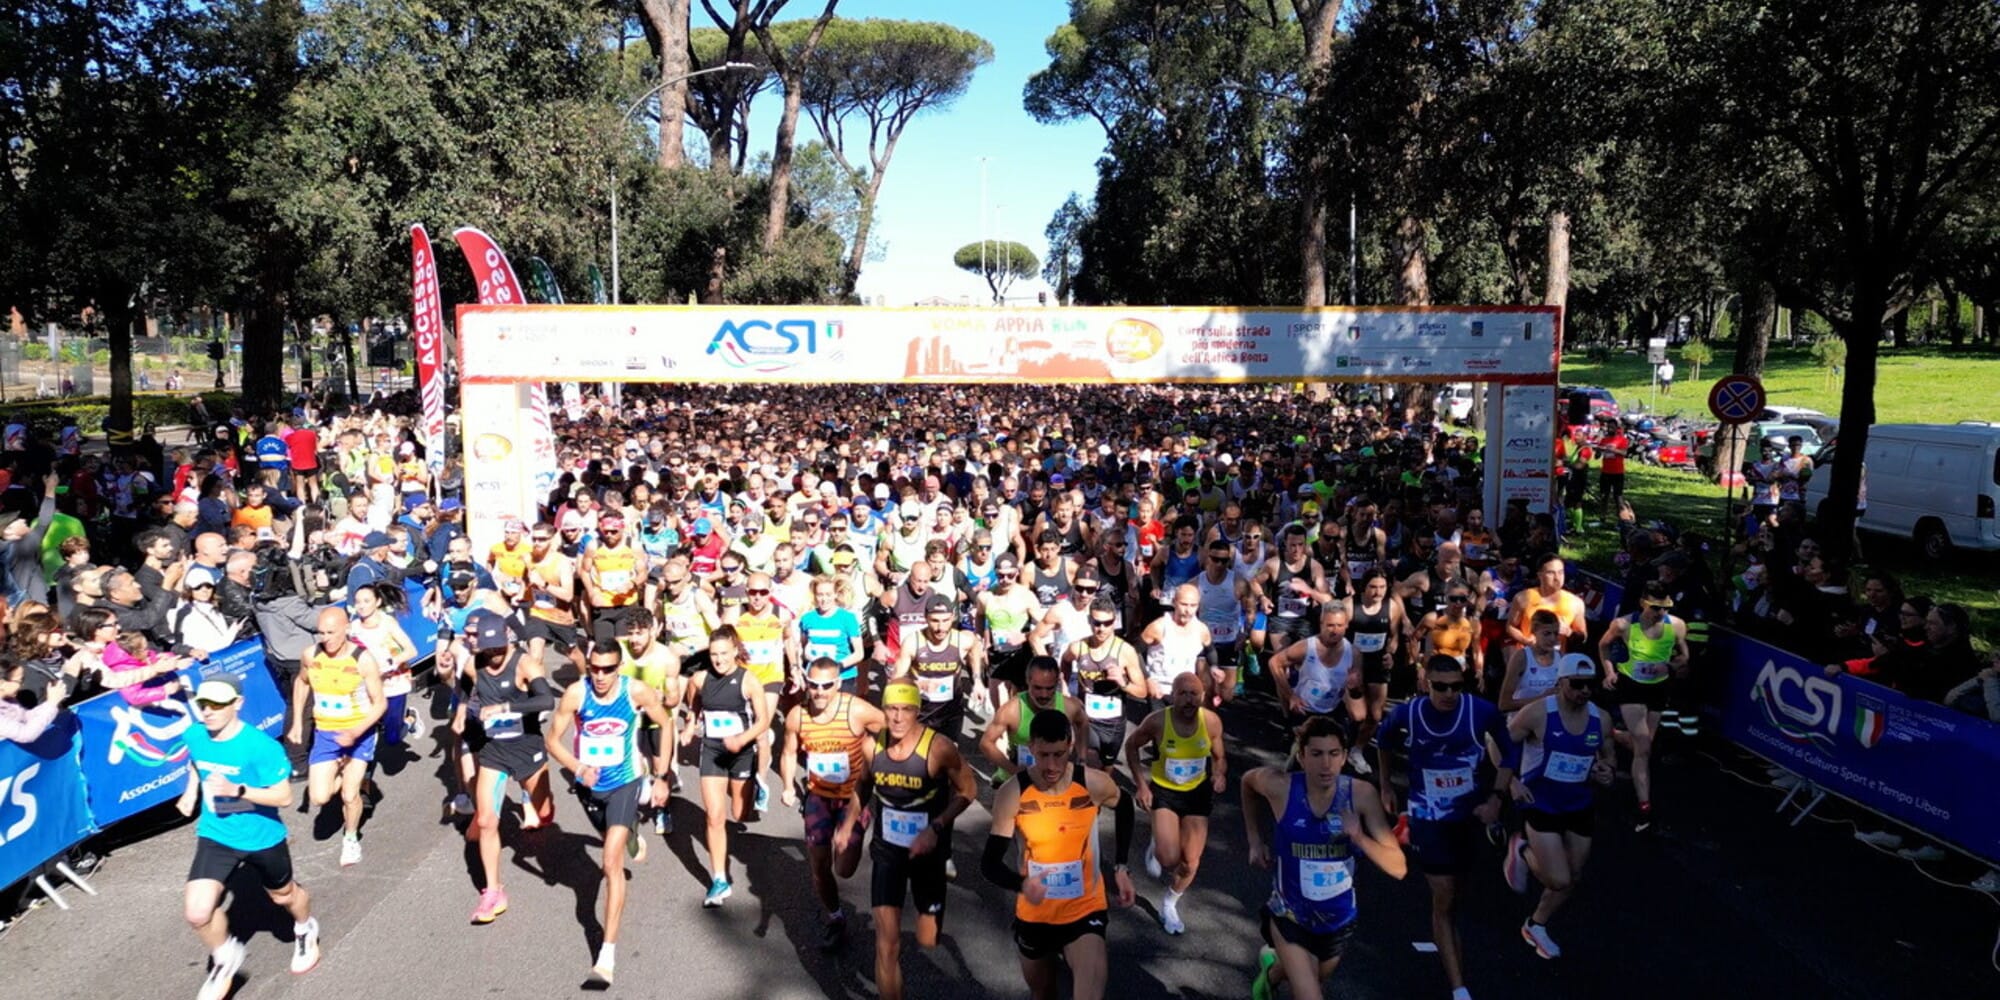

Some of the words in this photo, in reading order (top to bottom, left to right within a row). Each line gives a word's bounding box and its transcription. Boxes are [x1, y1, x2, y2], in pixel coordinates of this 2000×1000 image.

[415, 249, 436, 365] ACCESSO
[1051, 316, 1088, 332] RUN
[1178, 325, 1206, 337] Corri
[1207, 324, 1233, 338] sulla
[1235, 325, 1271, 337] strada
[705, 319, 817, 355] ACSI
[1210, 339, 1257, 350] moderna
[1239, 351, 1269, 363] Roma
[1748, 659, 1843, 736] ACSI
[875, 771, 924, 790] X-SOLID
[1803, 750, 1840, 775] Cultura
[1839, 765, 1868, 788] Sport
[1877, 779, 1914, 806] Tempo
[1914, 796, 1951, 821] Libero
